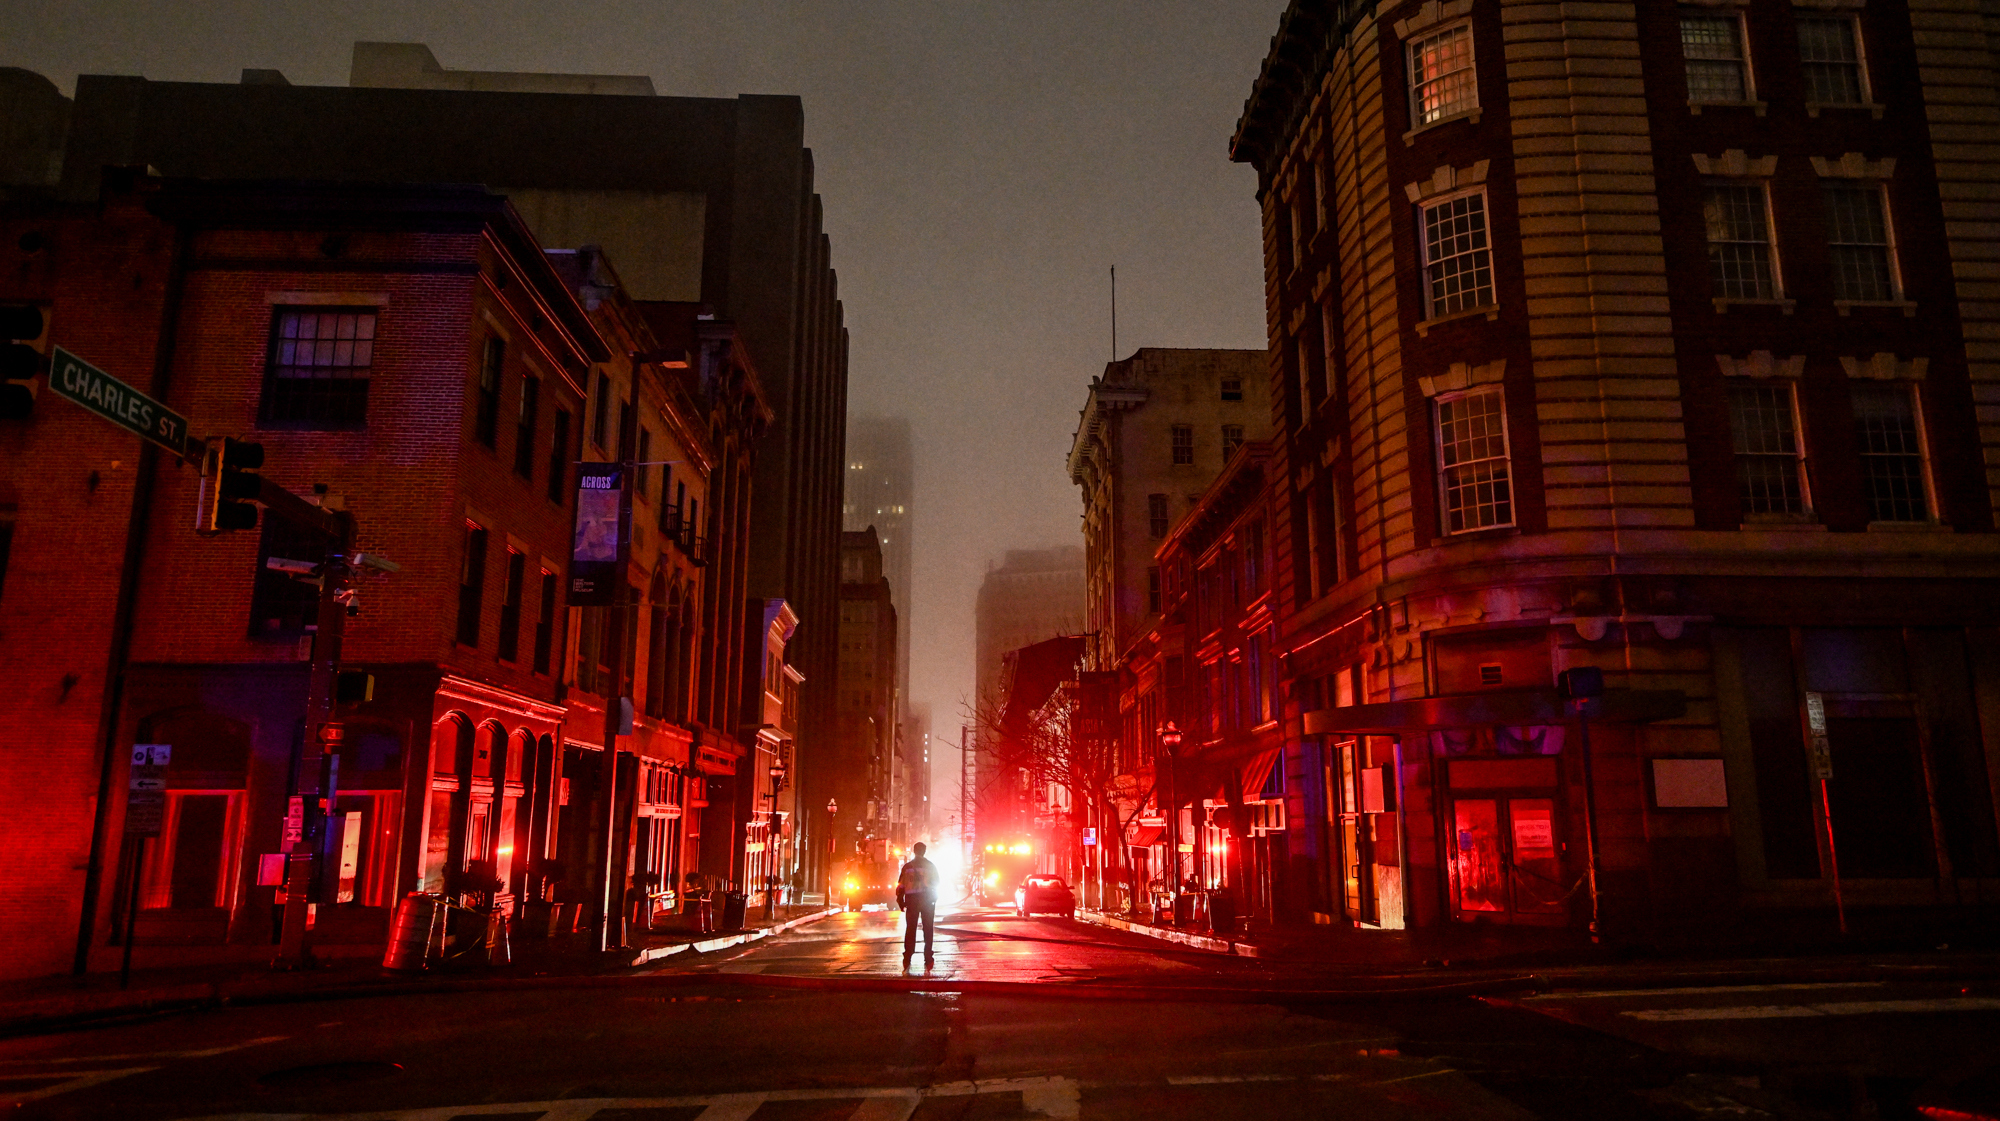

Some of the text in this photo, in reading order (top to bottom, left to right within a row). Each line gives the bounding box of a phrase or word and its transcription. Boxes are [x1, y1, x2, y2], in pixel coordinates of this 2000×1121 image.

[63, 363, 180, 444] CHARLES ST.
[581, 475, 611, 489] ACROSS
[1080, 718, 1099, 734] ASIA
